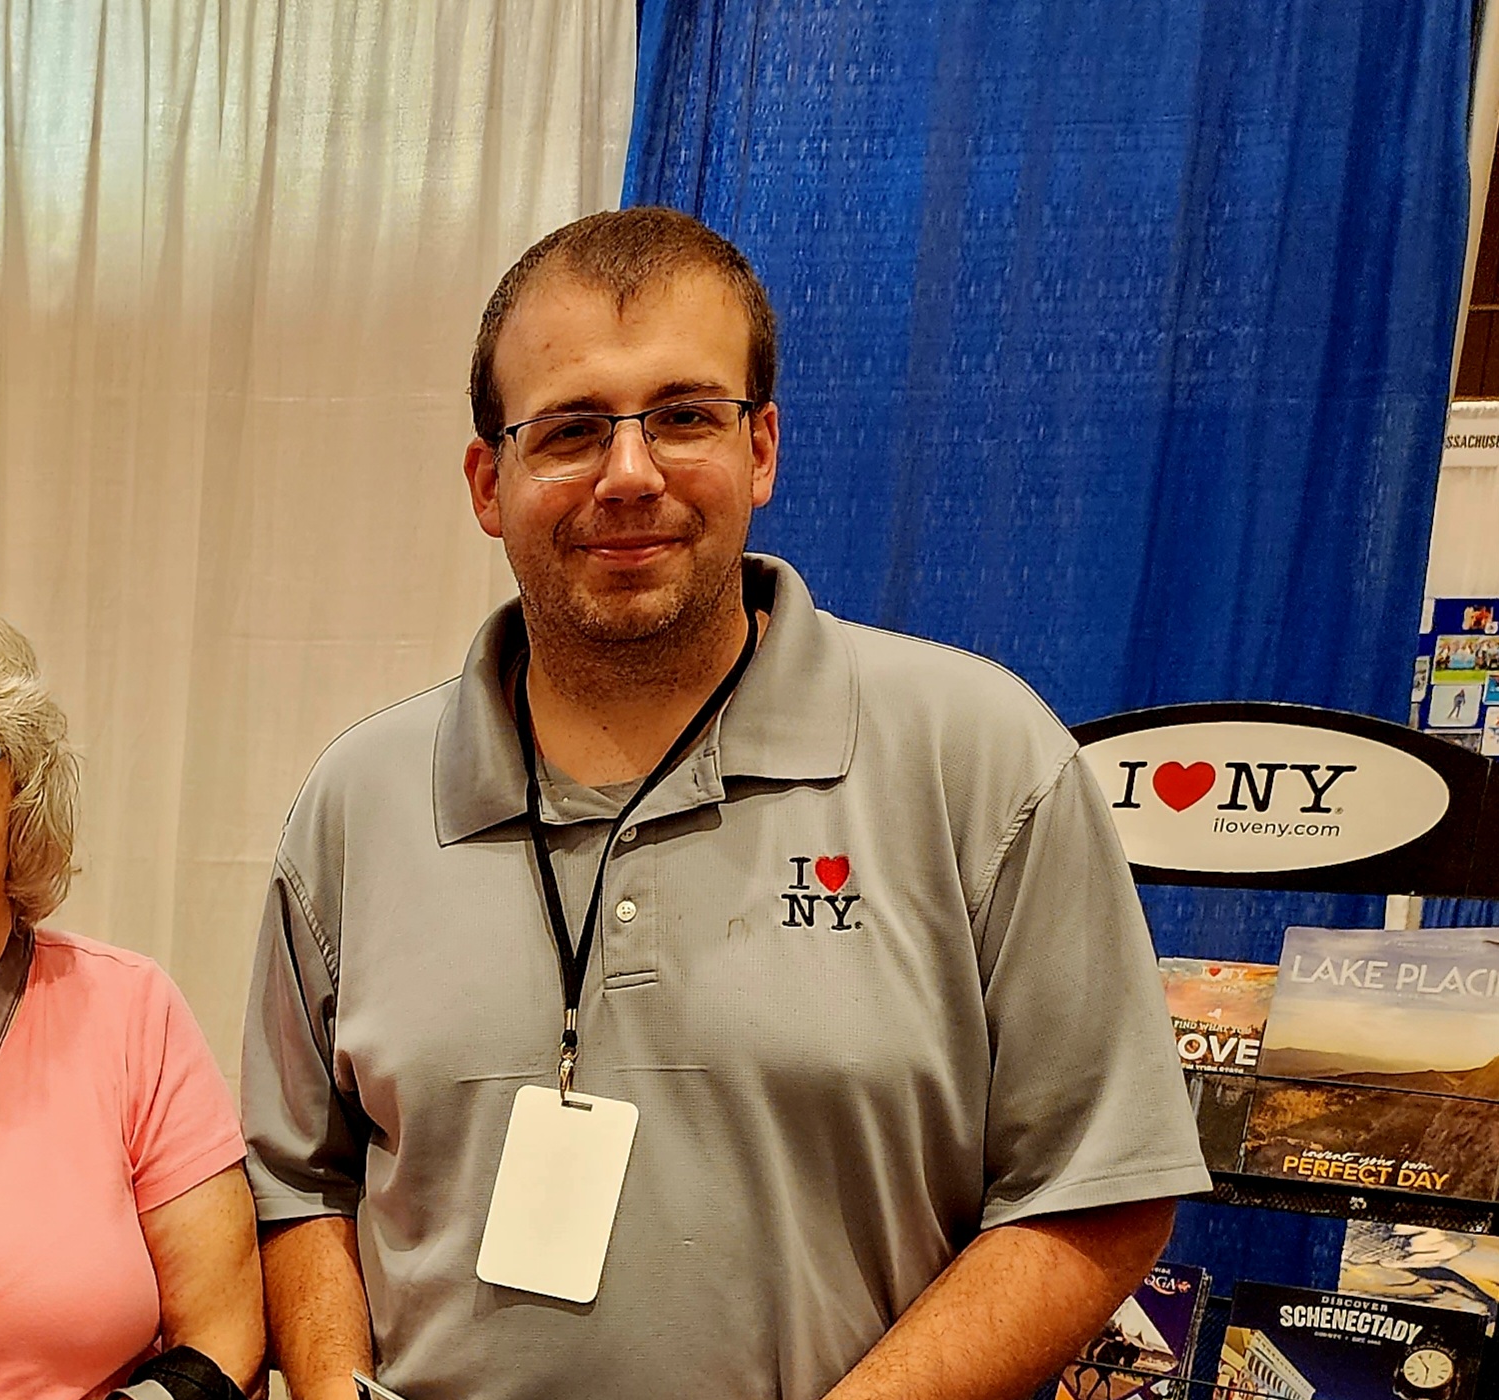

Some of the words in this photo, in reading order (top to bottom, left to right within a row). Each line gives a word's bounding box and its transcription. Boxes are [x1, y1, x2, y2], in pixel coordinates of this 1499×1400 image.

[1111, 761, 1148, 809] I
[1217, 762, 1357, 813] NY
[1212, 817, 1341, 838] iloveny.com
[788, 856, 812, 890] I
[780, 893, 861, 931] NY
[1291, 955, 1389, 990] LAKE
[1282, 1155, 1393, 1186] PERFECT
[1397, 1169, 1450, 1190] DAY
[1321, 1296, 1389, 1313] DISCOVER
[1279, 1305, 1424, 1346] SCHENECTADY
